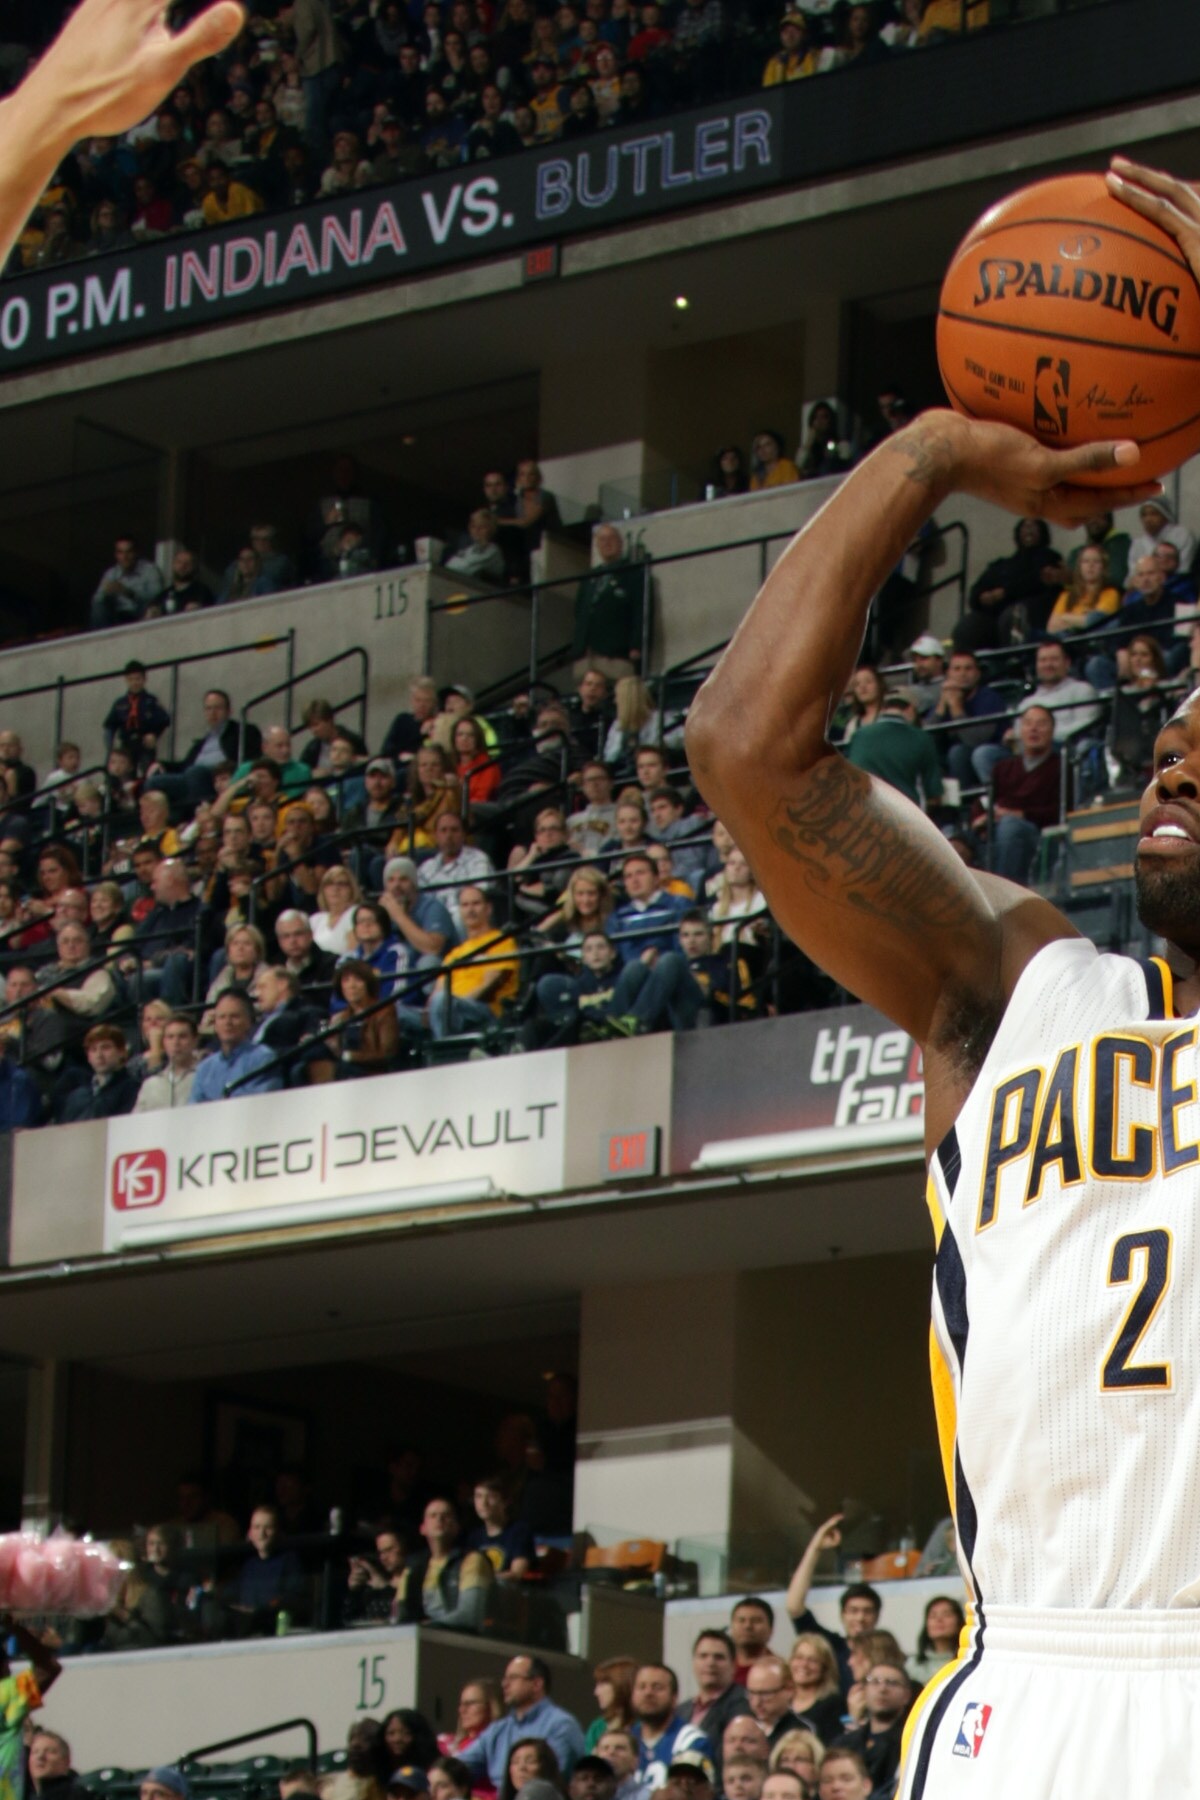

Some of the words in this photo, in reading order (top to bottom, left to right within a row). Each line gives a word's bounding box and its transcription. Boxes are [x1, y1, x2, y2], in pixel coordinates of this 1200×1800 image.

[46, 267, 145, 341] P.M.
[163, 200, 408, 313] INDIANA
[421, 175, 515, 245] VS.
[535, 109, 773, 220] BUTLER
[974, 258, 1181, 337] SPALDING
[810, 1025, 912, 1084] the
[608, 1131, 647, 1174] EXIT
[1100, 1226, 1174, 1392] 2
[355, 1653, 386, 1710] 15
